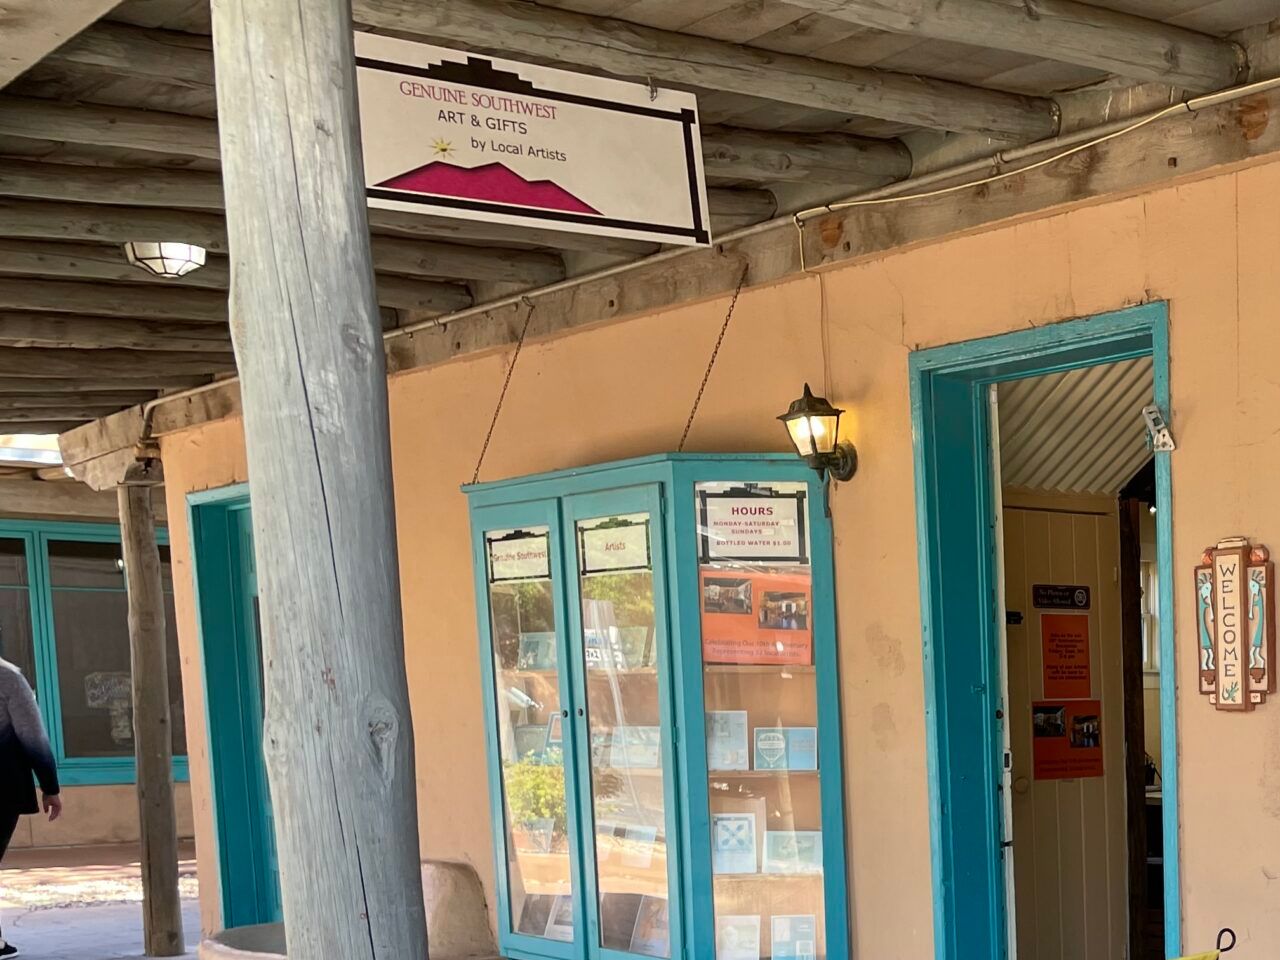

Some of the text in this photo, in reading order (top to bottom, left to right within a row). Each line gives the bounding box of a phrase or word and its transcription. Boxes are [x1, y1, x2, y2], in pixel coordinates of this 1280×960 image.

[399, 80, 557, 120] GENUINE SOUTHWEST
[438, 109, 527, 135] ART & GIFTS
[471, 136, 567, 162] by Local Artists
[731, 506, 774, 516] HOURS
[604, 541, 626, 552] Artists
[1219, 563, 1238, 677] WELCOME
